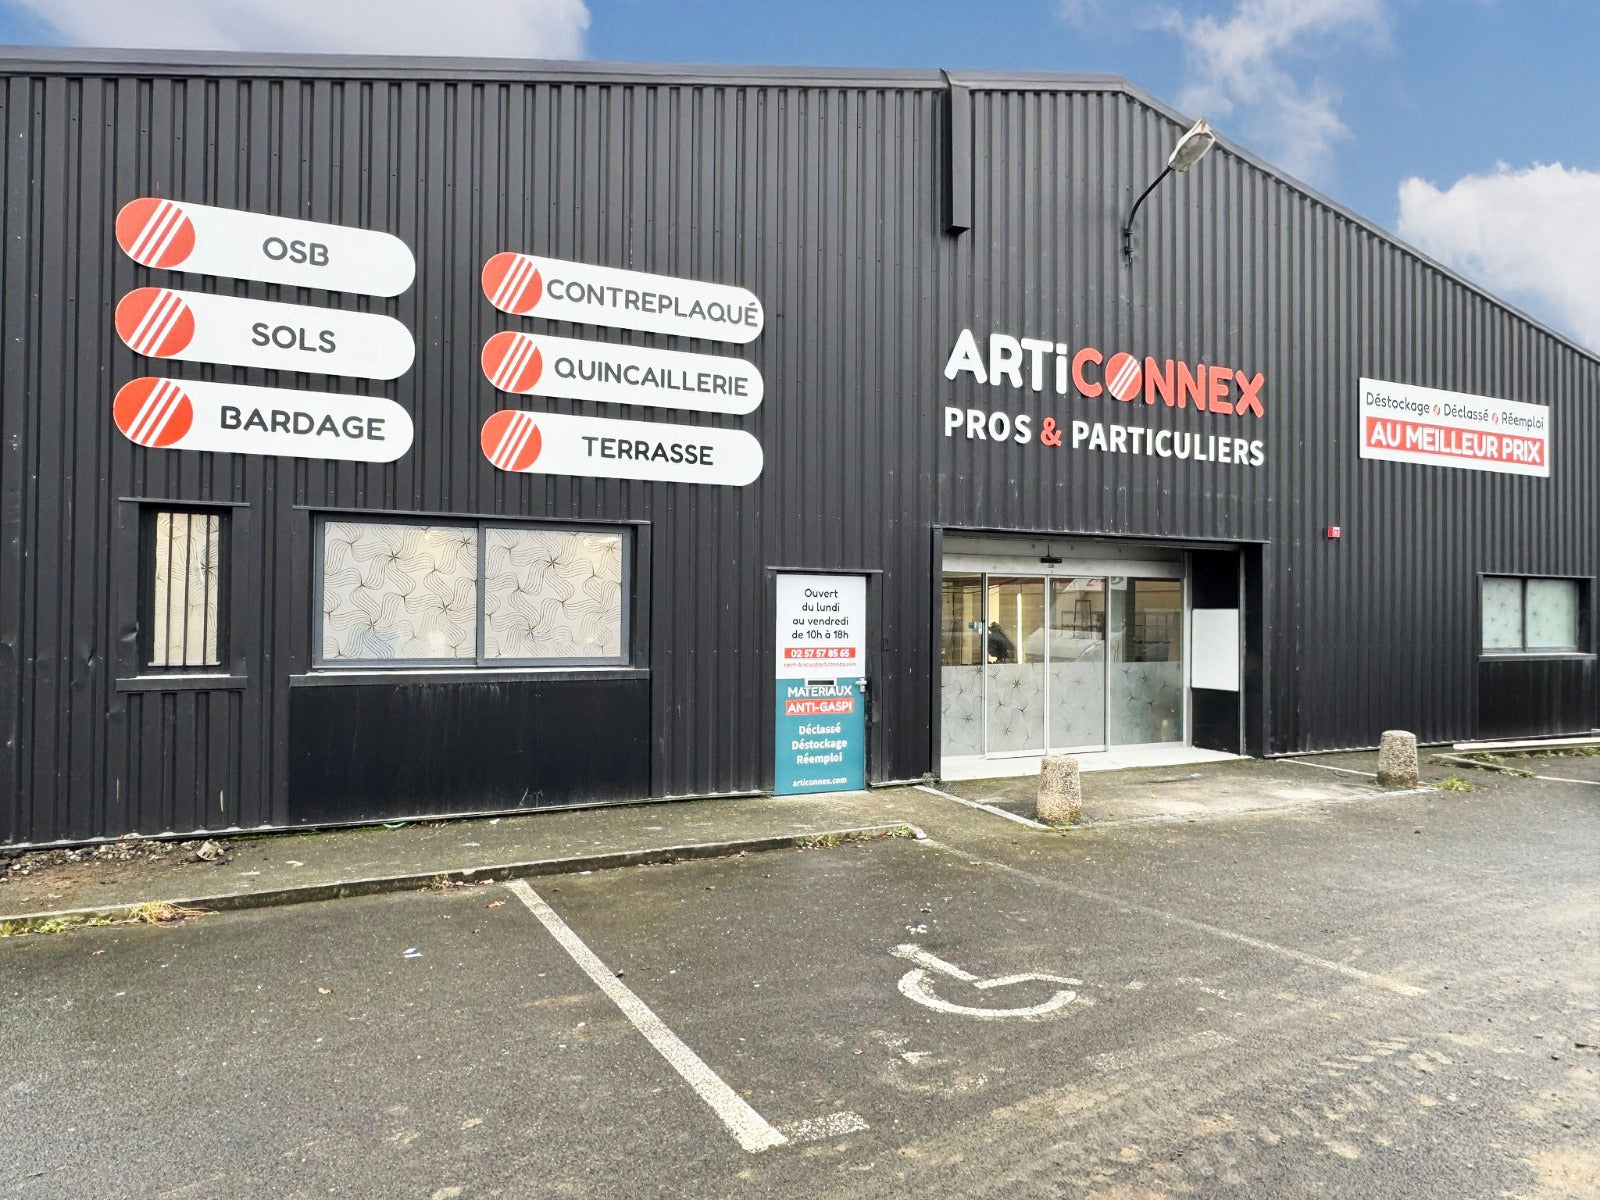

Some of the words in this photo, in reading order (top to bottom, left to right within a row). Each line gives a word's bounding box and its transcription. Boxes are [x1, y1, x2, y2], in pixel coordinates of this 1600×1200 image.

[262, 236, 330, 267] OSB
[546, 278, 759, 328] CONTREPLAQUÉ
[251, 322, 337, 354] SOLS
[554, 357, 749, 397] QUINCAILLERIE
[1366, 392, 1430, 416] Déstockage
[1443, 403, 1489, 422] Déclassé
[1501, 411, 1545, 431] Réemploi
[220, 405, 386, 441] BARDAGE
[944, 406, 1032, 444] PROS
[1040, 417, 1062, 447] &
[1072, 420, 1265, 466] PARTICULIERS
[1370, 421, 1401, 447] AU
[1405, 424, 1499, 459] MEILLEUR
[1502, 438, 1541, 463] PRIX
[581, 436, 714, 466] TERRASSE
[804, 588, 838, 598] Ouvert
[801, 602, 814, 612] du
[816, 602, 840, 612] lundi
[792, 618, 804, 626] au
[807, 616, 849, 626] vendredi
[792, 630, 804, 639] de
[806, 630, 822, 639] 10h
[833, 630, 849, 639] 18h
[791, 649, 802, 658] 02
[804, 649, 815, 658] 57
[816, 649, 827, 658] 57
[787, 701, 853, 713] ANTI-GASPI
[798, 722, 842, 735] Déclassé
[791, 738, 848, 750] Déstockage
[796, 752, 843, 765] Réemploi
[792, 777, 847, 788] articonnex.com
